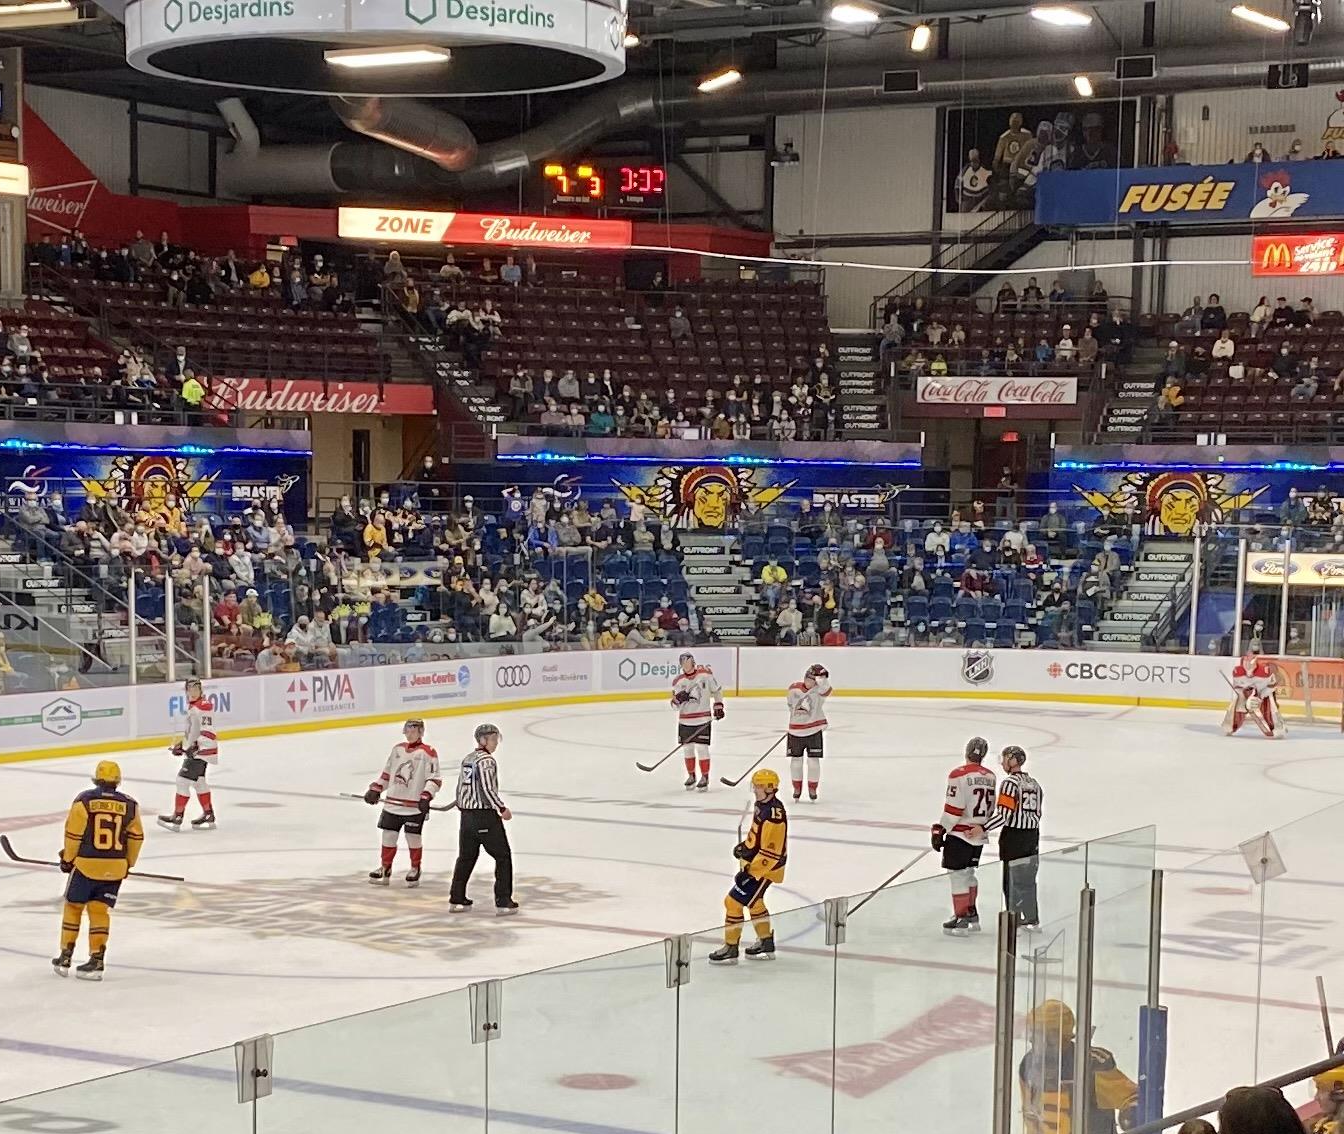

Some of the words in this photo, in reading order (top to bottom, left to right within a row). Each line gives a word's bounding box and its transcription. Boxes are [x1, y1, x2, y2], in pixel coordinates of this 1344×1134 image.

[188, 0, 294, 23] Desjardins
[446, 0, 555, 29] Desjardins
[1119, 174, 1236, 213] FUSÉE
[375, 216, 435, 234] ZONE
[480, 217, 593, 244] Budweiser
[312, 674, 355, 704] PMA
[770, 806, 783, 820] 15
[93, 813, 123, 851] 61
